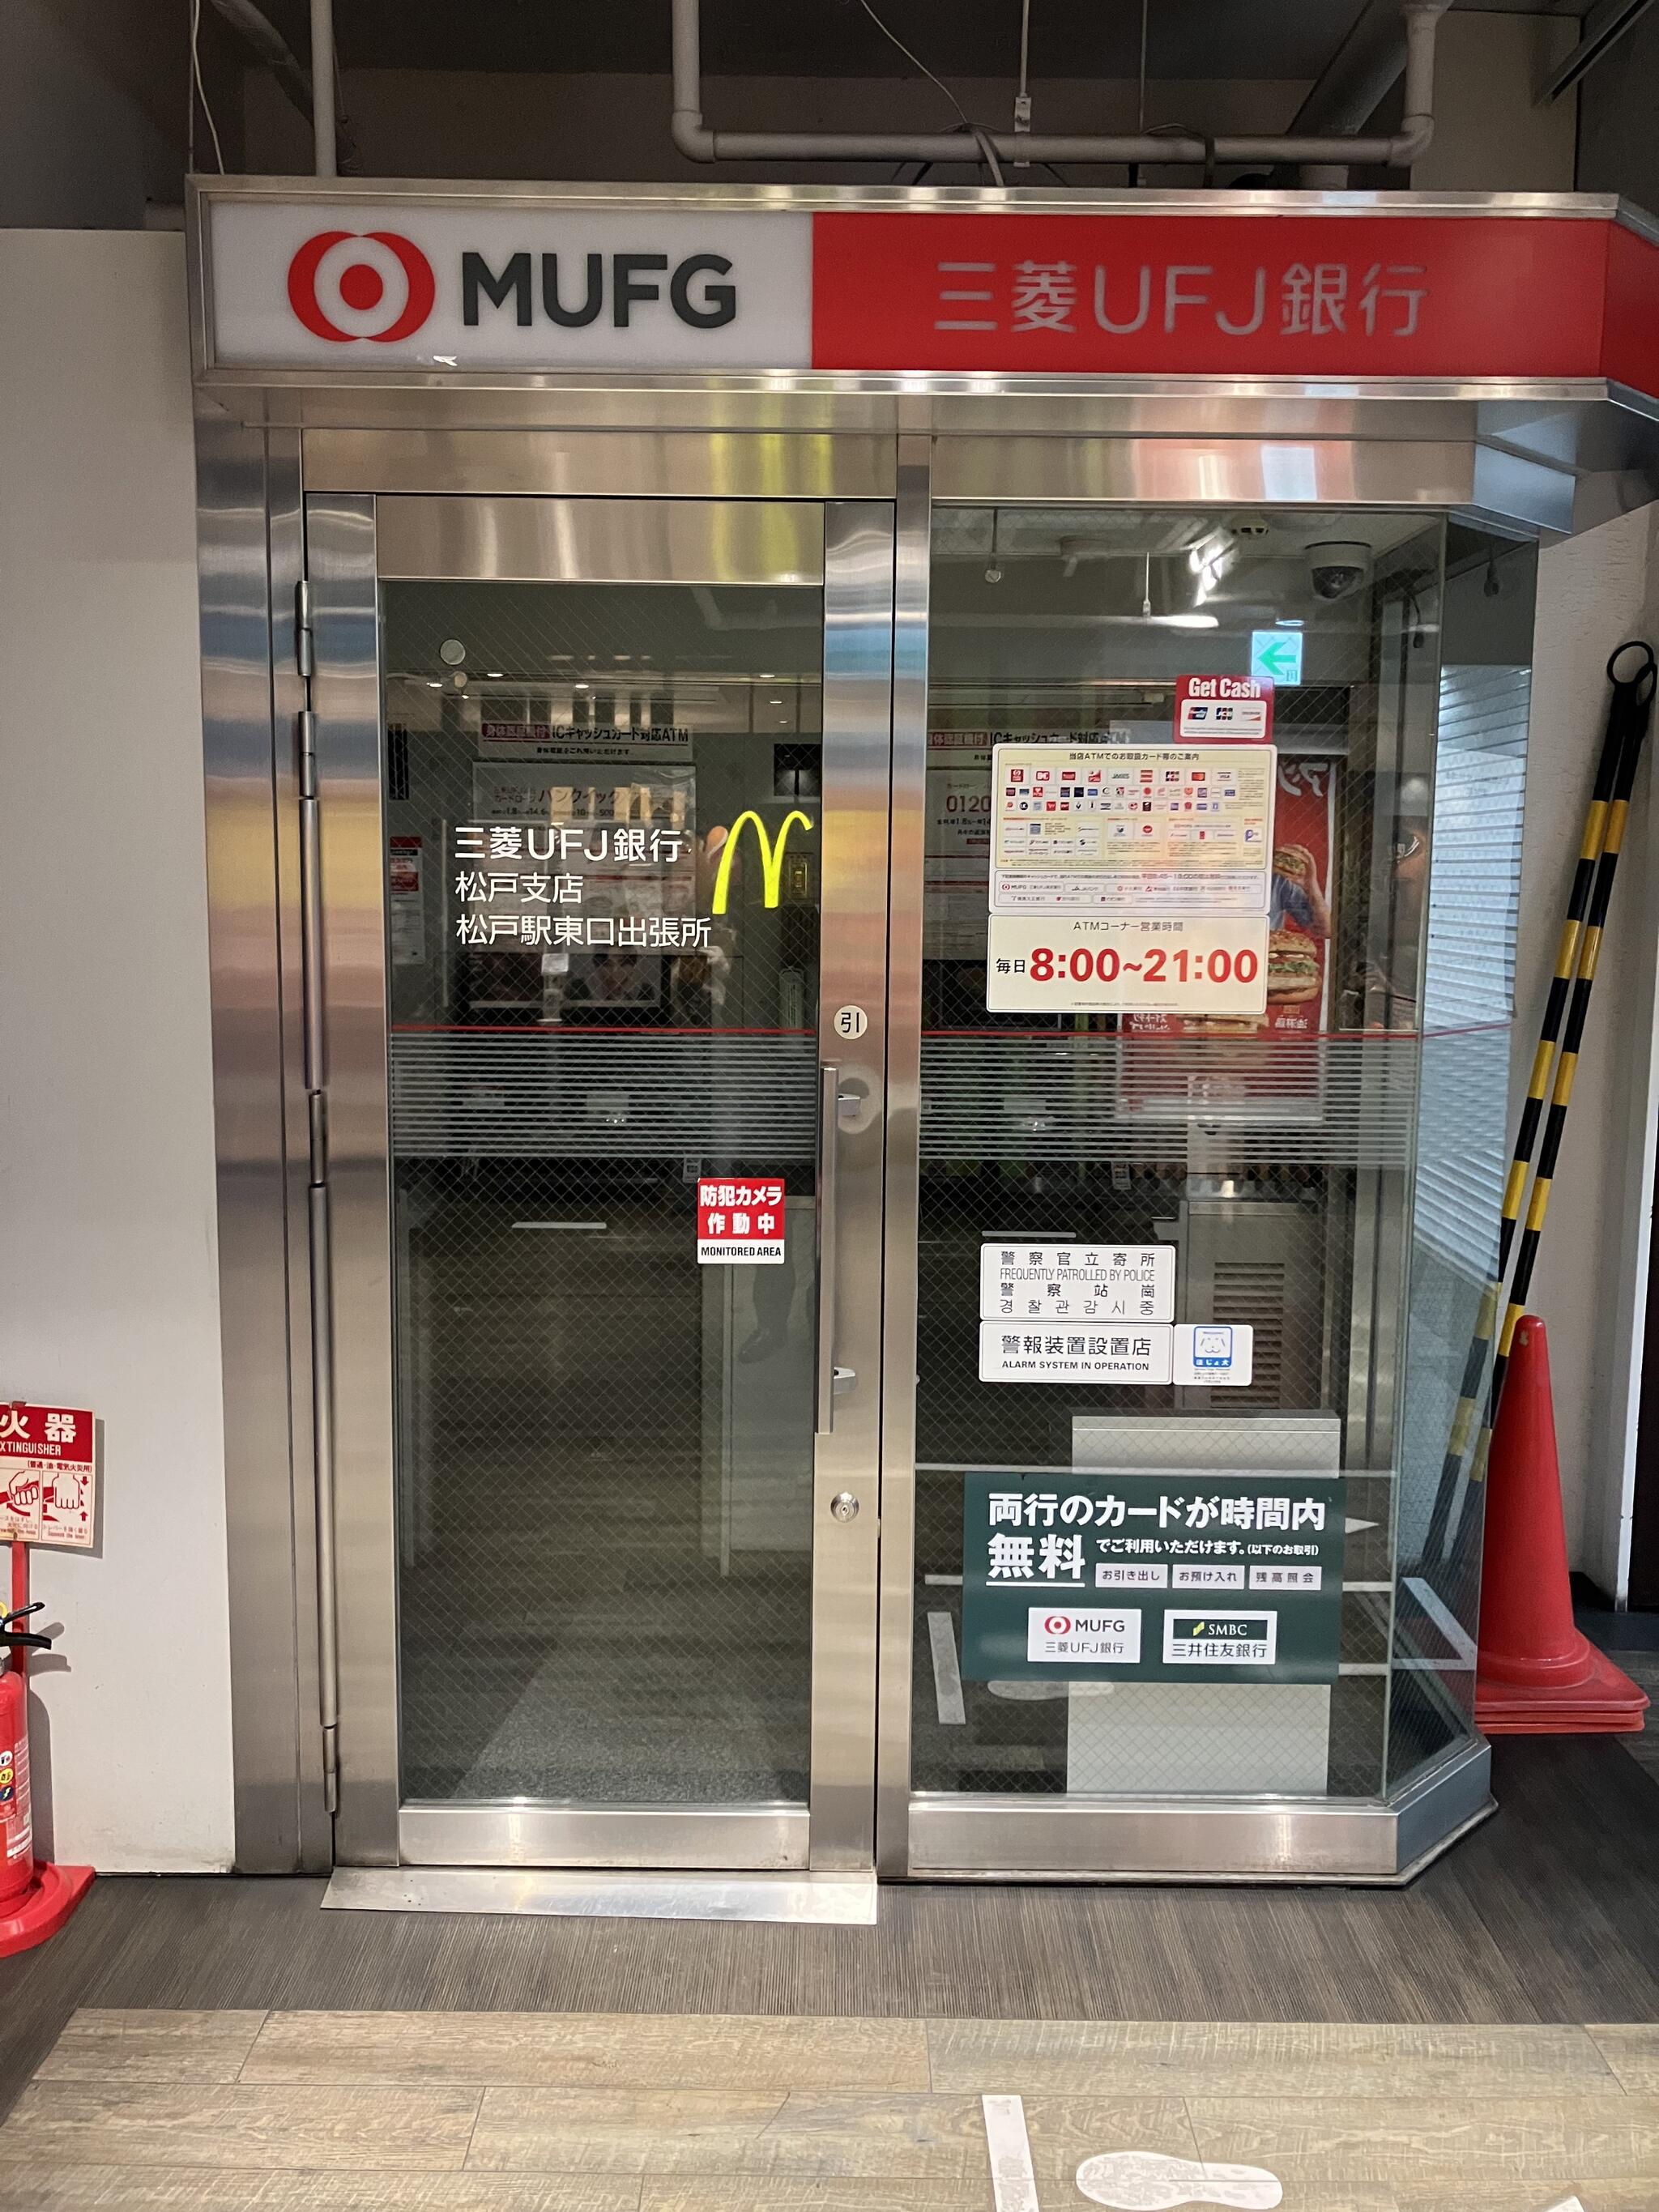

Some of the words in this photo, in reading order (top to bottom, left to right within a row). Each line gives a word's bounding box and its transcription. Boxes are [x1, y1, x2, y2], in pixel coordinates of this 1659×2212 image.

[462, 251, 736, 329] MUFG
[935, 259, 1428, 337] 三菱UFJ銀行
[1188, 678, 1217, 697] Get
[1219, 678, 1261, 698] Cash
[454, 825, 683, 863] 三菱UFJ銀行
[454, 872, 583, 905] 松戸支店
[455, 914, 712, 948] 松戸駅東口出張所
[1073, 921, 1183, 932] ATMコーナー営業時間
[996, 958, 1025, 974] 毎日
[1030, 948, 1258, 983] 8:00~21:00
[840, 1012, 860, 1034] 引
[700, 1185, 783, 1207] 防犯カメラ
[707, 1213, 775, 1234] 作動中
[701, 1247, 755, 1256] MONITORED
[757, 1247, 782, 1256] AREA
[1001, 1251, 1155, 1267] 警察官立寄所
[1000, 1268, 1055, 1281] FREQUENTLY
[1056, 1268, 1107, 1281] PATROLLED
[1110, 1269, 1120, 1281] BY
[1124, 1269, 1155, 1281] POLICE
[1001, 1335, 1151, 1356] 警報装置設置店
[1002, 1361, 1037, 1369] ALARM
[1039, 1361, 1078, 1370] SYSTEM
[1081, 1362, 1091, 1370] IN
[1094, 1362, 1149, 1370] OPERATION
[987, 1492, 1326, 1531] 両行のカードが時間内
[987, 1533, 1085, 1579] 無料
[1096, 1537, 1245, 1556] でご利用いただけます。
[1247, 1544, 1320, 1556] (以下のお取引)
[1102, 1570, 1160, 1581] お引き出し
[1179, 1571, 1238, 1583] お預け入れ
[1256, 1572, 1314, 1583] 残高照会
[1075, 1618, 1125, 1633] MUFG
[1208, 1624, 1247, 1636] SMBC
[1045, 1641, 1124, 1654] 三菱UFJ銀行
[1172, 1643, 1268, 1658] 三井住友銀行
